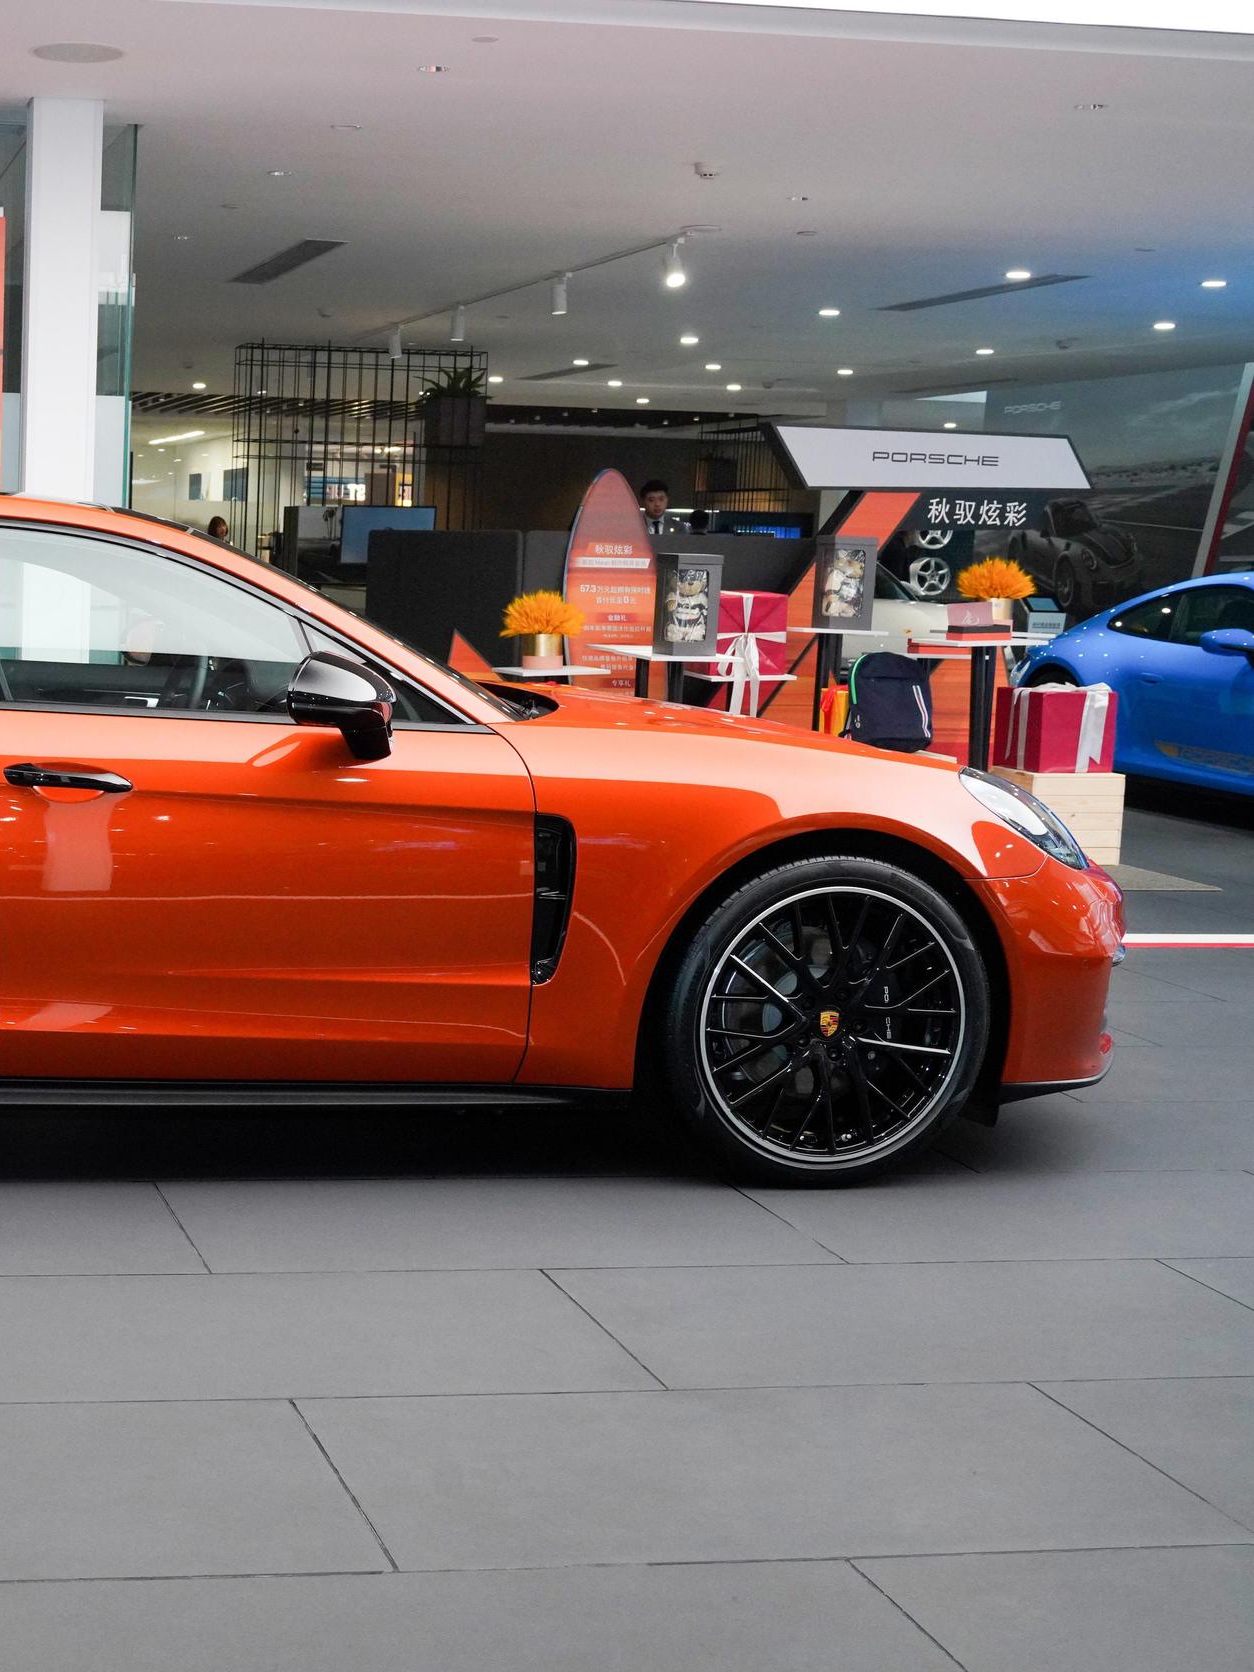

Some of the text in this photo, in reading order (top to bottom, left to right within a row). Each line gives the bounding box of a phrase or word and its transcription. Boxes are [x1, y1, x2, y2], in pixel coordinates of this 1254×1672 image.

[872, 451, 999, 466] PORSCHE
[927, 497, 1027, 527] 秋驭炫彩
[594, 544, 634, 555] 秋驭炫彩
[580, 584, 597, 593] 57.3
